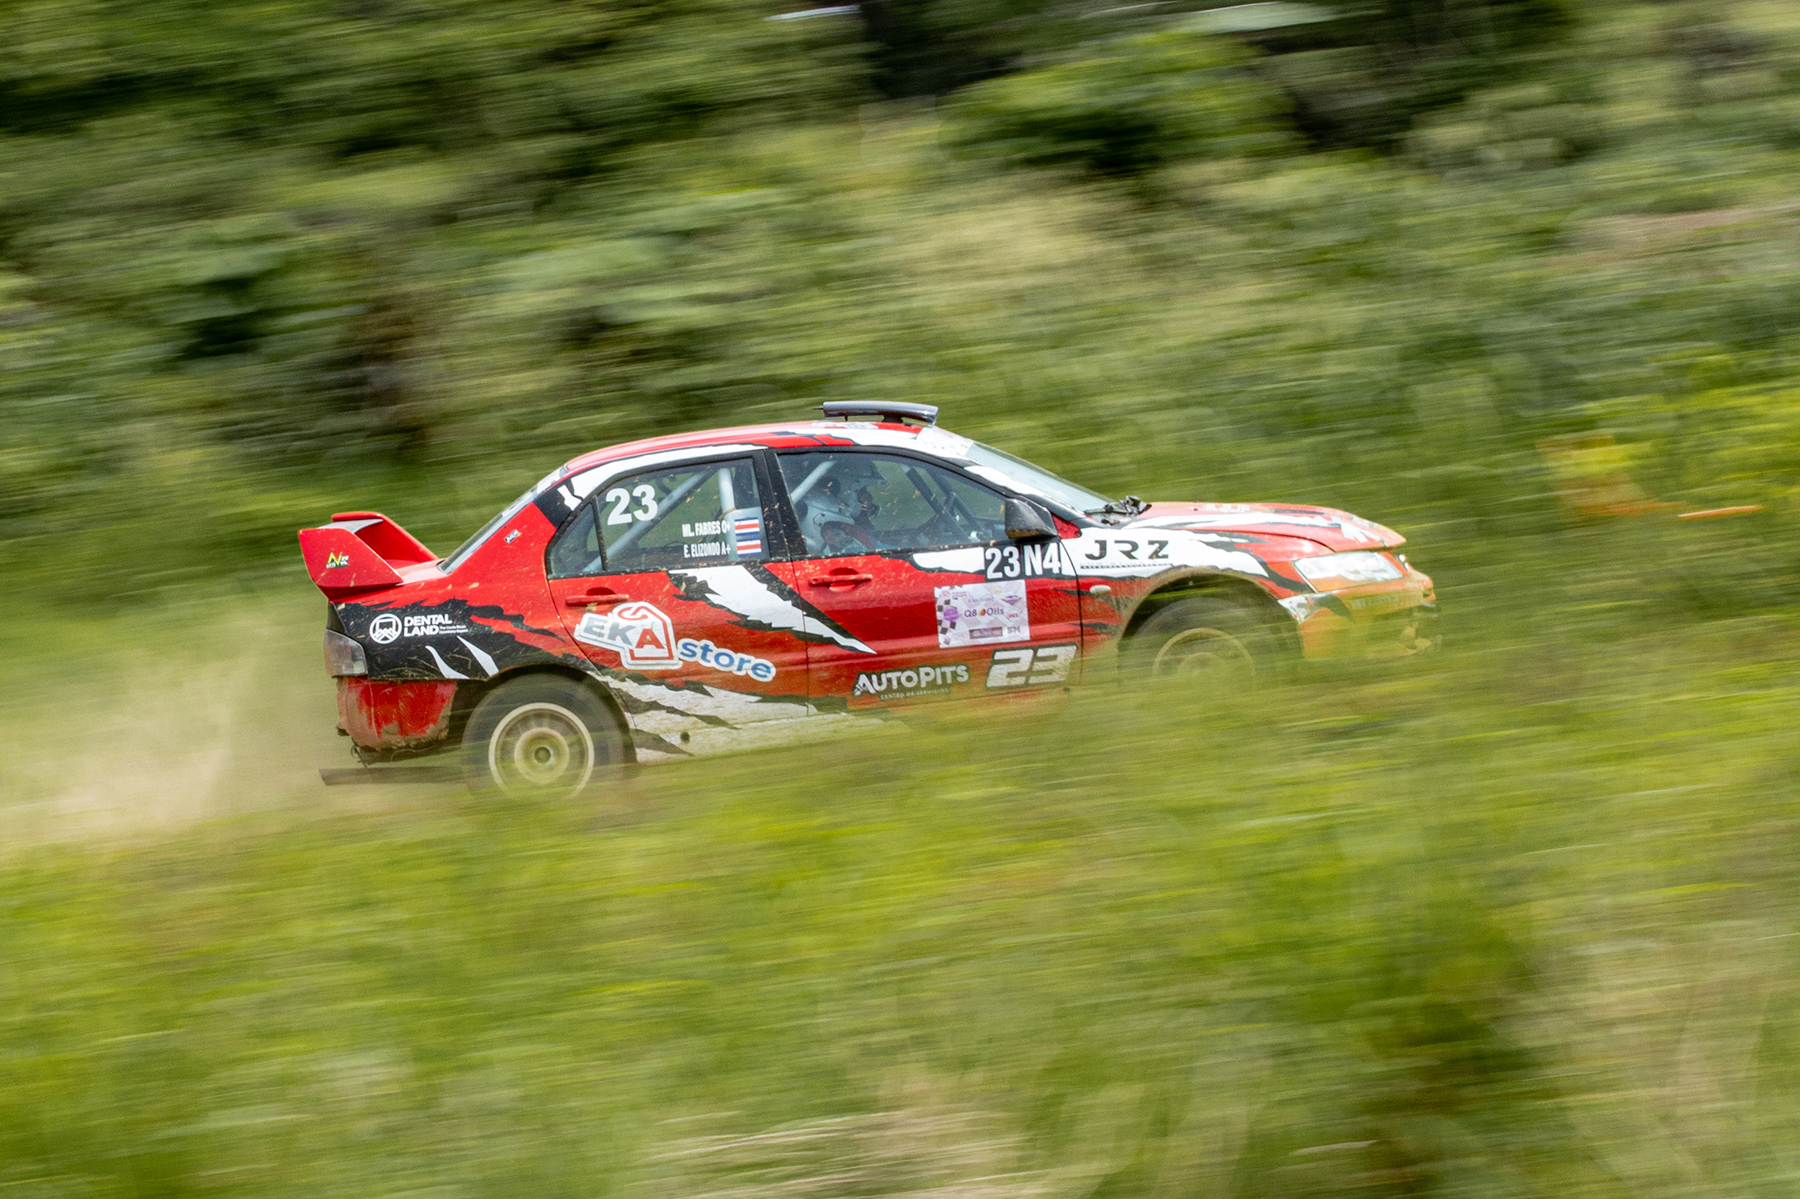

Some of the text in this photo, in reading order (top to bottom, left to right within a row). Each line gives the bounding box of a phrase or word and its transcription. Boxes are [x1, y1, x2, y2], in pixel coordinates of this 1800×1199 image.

[606, 484, 658, 525] 23
[695, 520, 720, 536] FABRES
[721, 520, 731, 534] O+
[684, 541, 731, 558] E. ELIZONDO A+
[1084, 540, 1169, 560] JRZ
[985, 542, 1061, 579] 23 N4
[404, 613, 453, 627] DENTAL
[964, 609, 978, 618] Q8
[404, 625, 439, 637] LAND
[583, 616, 665, 650] EKA
[680, 641, 771, 679] store
[986, 645, 1077, 687] 23
